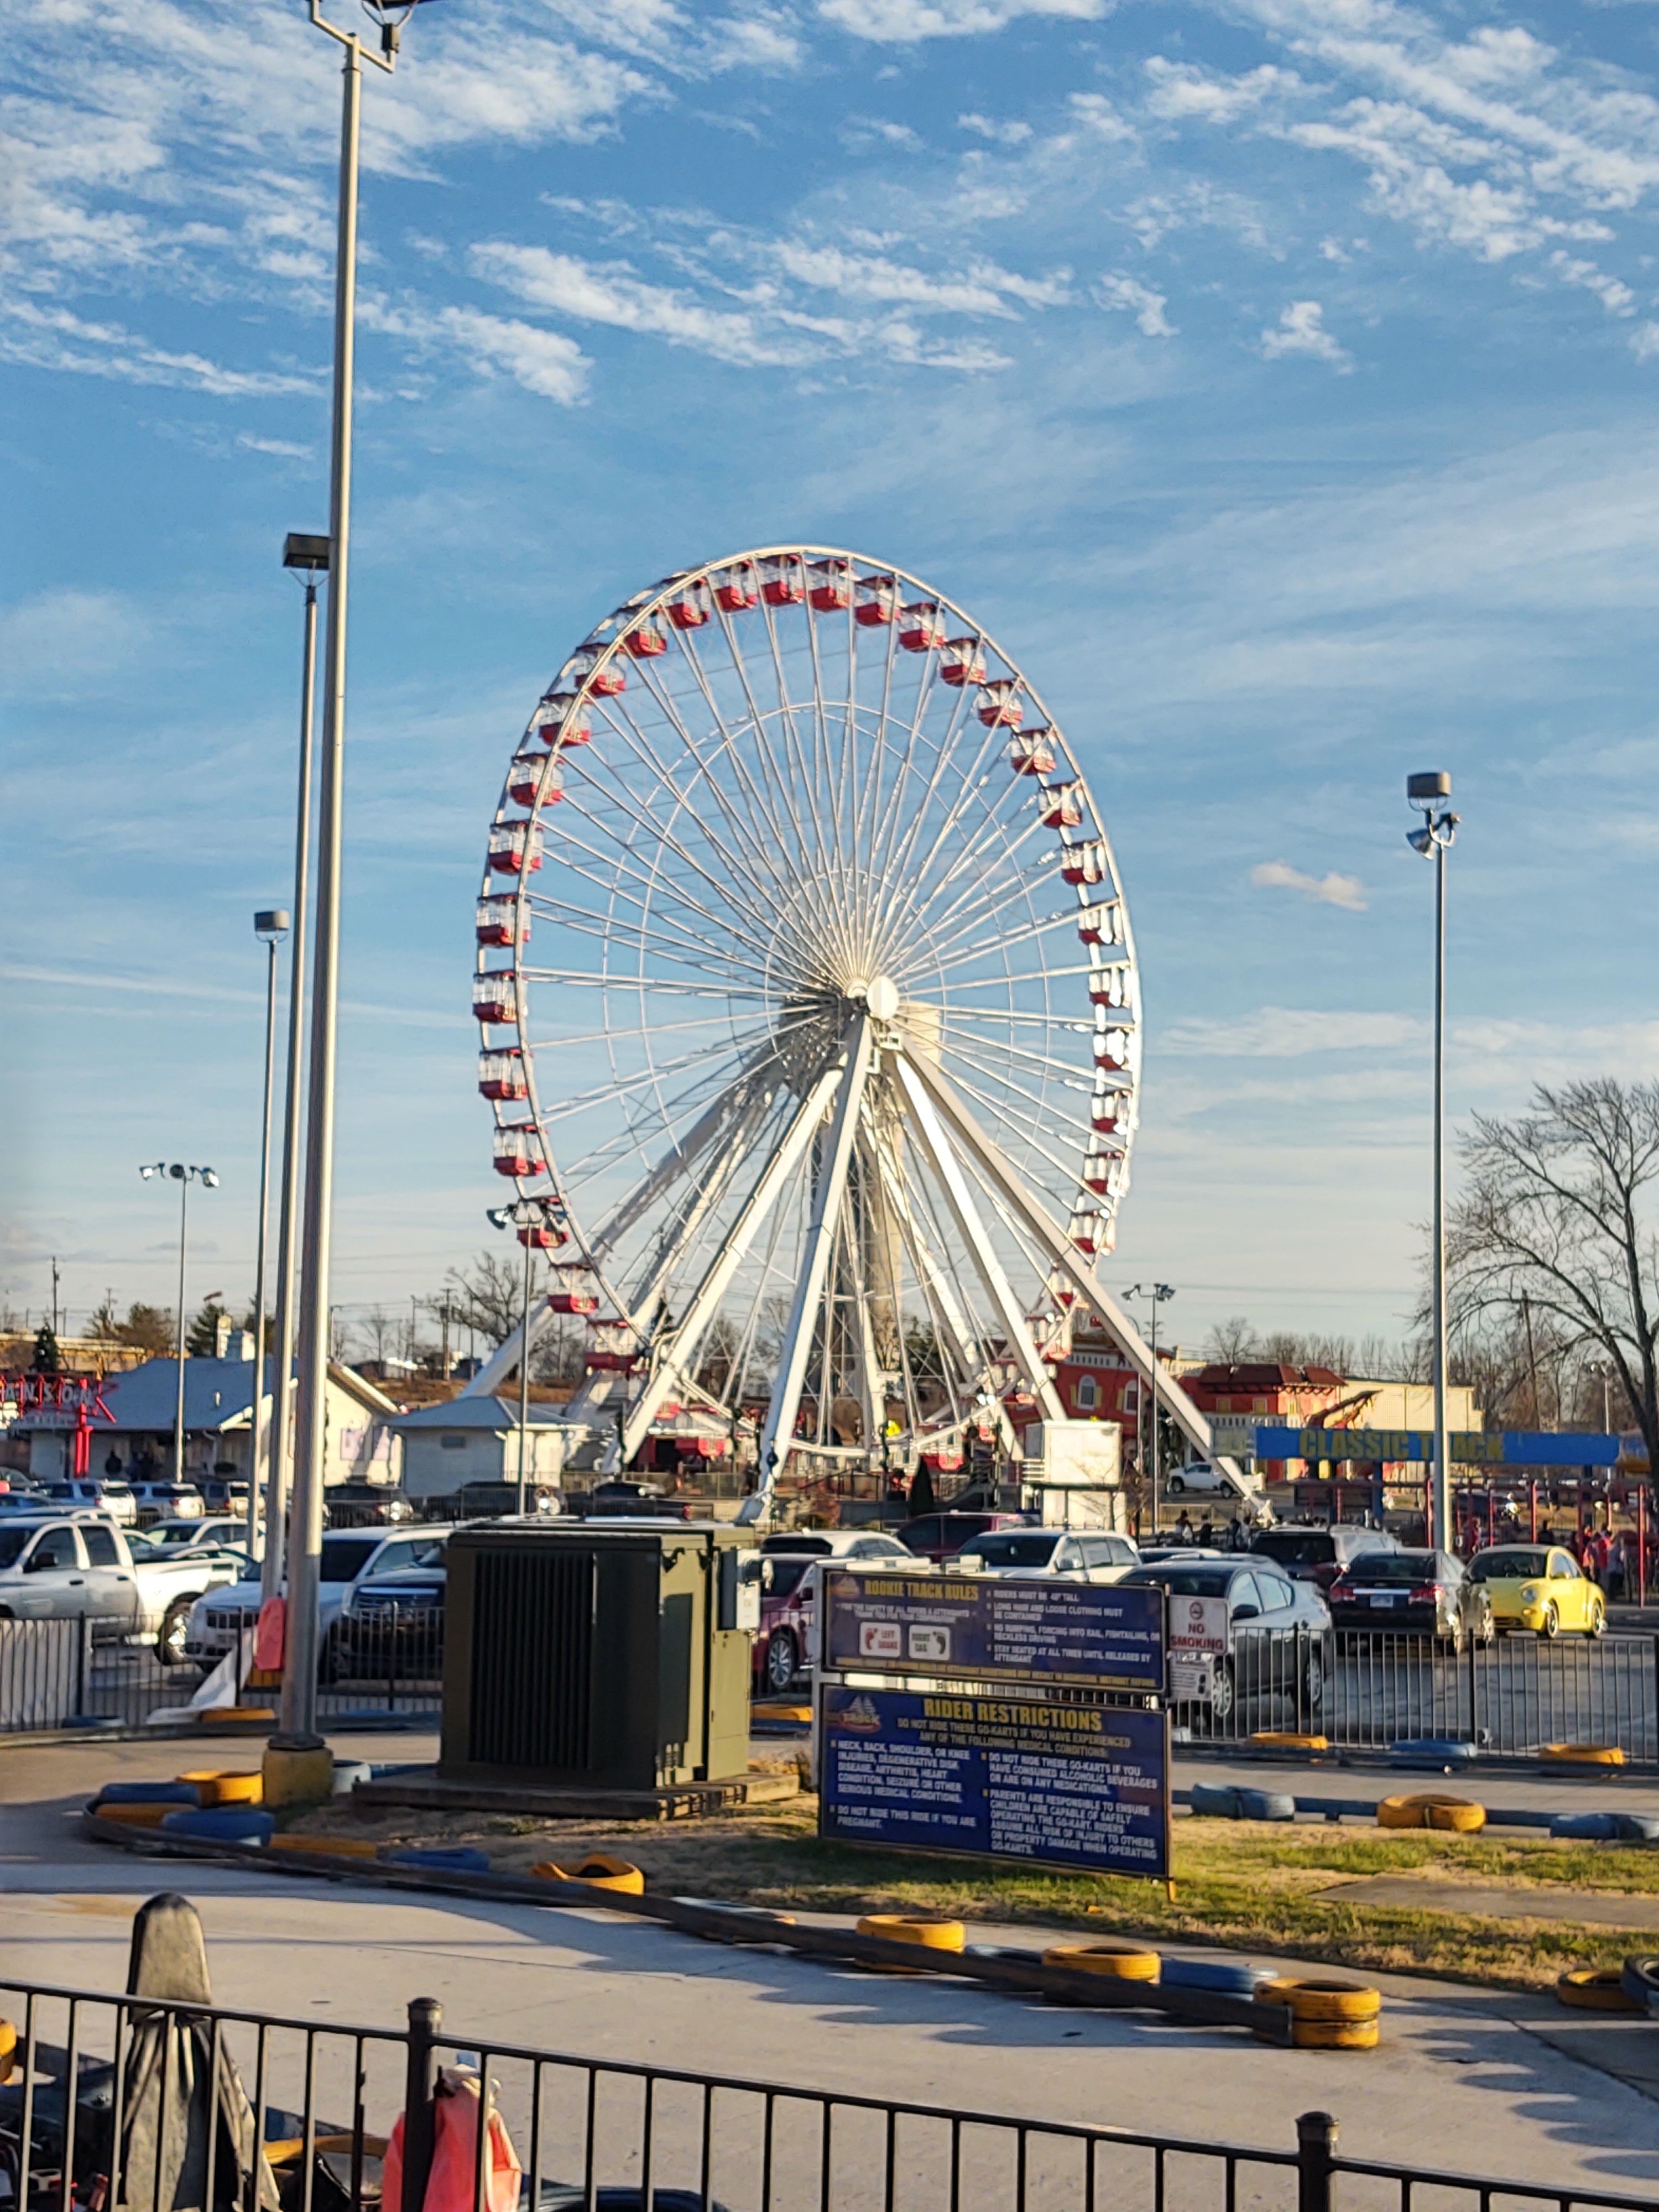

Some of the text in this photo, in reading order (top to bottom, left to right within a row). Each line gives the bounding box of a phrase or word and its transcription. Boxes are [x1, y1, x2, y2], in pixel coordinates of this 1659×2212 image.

[1298, 1429, 1504, 1462] CLASSIC TACK
[865, 1580, 904, 1597] ROOKIE
[907, 1583, 942, 1599] TRACK
[945, 1584, 978, 1600] RULES
[994, 1590, 1017, 1599] RIDERS
[994, 1603, 1123, 1617] LONG HAIR AND LOOSE CLOTHING MUST
[994, 1633, 1027, 1642] RECKLESS
[1039, 1626, 1067, 1635] FORCING
[1068, 1628, 1085, 1636] INTO
[1188, 1623, 1205, 1634] NO
[1170, 1635, 1224, 1650] SMOKING
[994, 1645, 1150, 1662] STAY SEATED AT ALL TIMES UNTIL RELEASED BY
[924, 1699, 1103, 1731] RIDER RESTRICTIONS
[898, 1718, 1131, 1749] DO NOT RIDE THESE GO-KARTS IF YOU HAVE EXPERIENCED
[920, 1731, 935, 1742] ANY
[937, 1733, 948, 1743] OF
[951, 1734, 966, 1745] THE
[1017, 1740, 1053, 1752] MEDICAL
[838, 1740, 862, 1751] NECK,
[863, 1743, 887, 1754] BACK,
[935, 1749, 946, 1758] OR
[948, 1750, 970, 1760] KNEE
[879, 1754, 937, 1768] DEGENERATIVE
[989, 1753, 1140, 1776] DO NOT RIDE THESE GO-KARTS IF YOU
[921, 1768, 947, 1780] HEART
[989, 1764, 1157, 1789] HAVE CONSUMED ALCOHOLIC BEVERAGES
[990, 1773, 1000, 1783] OR
[1003, 1775, 1019, 1785] ARE
[1021, 1777, 1032, 1786] ON
[1035, 1778, 1051, 1788] ANY
[838, 1782, 872, 1795] SERIOUS
[874, 1786, 909, 1798] MEDICAL
[886, 1777, 919, 1788] SEIZURE
[921, 1780, 932, 1790] OR
[935, 1781, 962, 1793] OTHER
[990, 1790, 1150, 1815] PARENTS ARE RESPONSIBLE TO ENSURE
[990, 1800, 1131, 1825] CHILDREN ARE CAPABLE OF SAFELY
[838, 1804, 977, 1827] DO NOT RIDE THIS RIDE IF YOU ARE
[990, 1810, 1035, 1823] OPERATING
[1038, 1815, 1053, 1825] THE
[1094, 1822, 1124, 1834] RIDERS
[991, 1820, 1154, 1848] ASSUME ALL RISK OF INJURY TO OTHERS
[991, 1830, 1157, 1859] OR PROPERTY DAMAGE WHEN OPERATING
